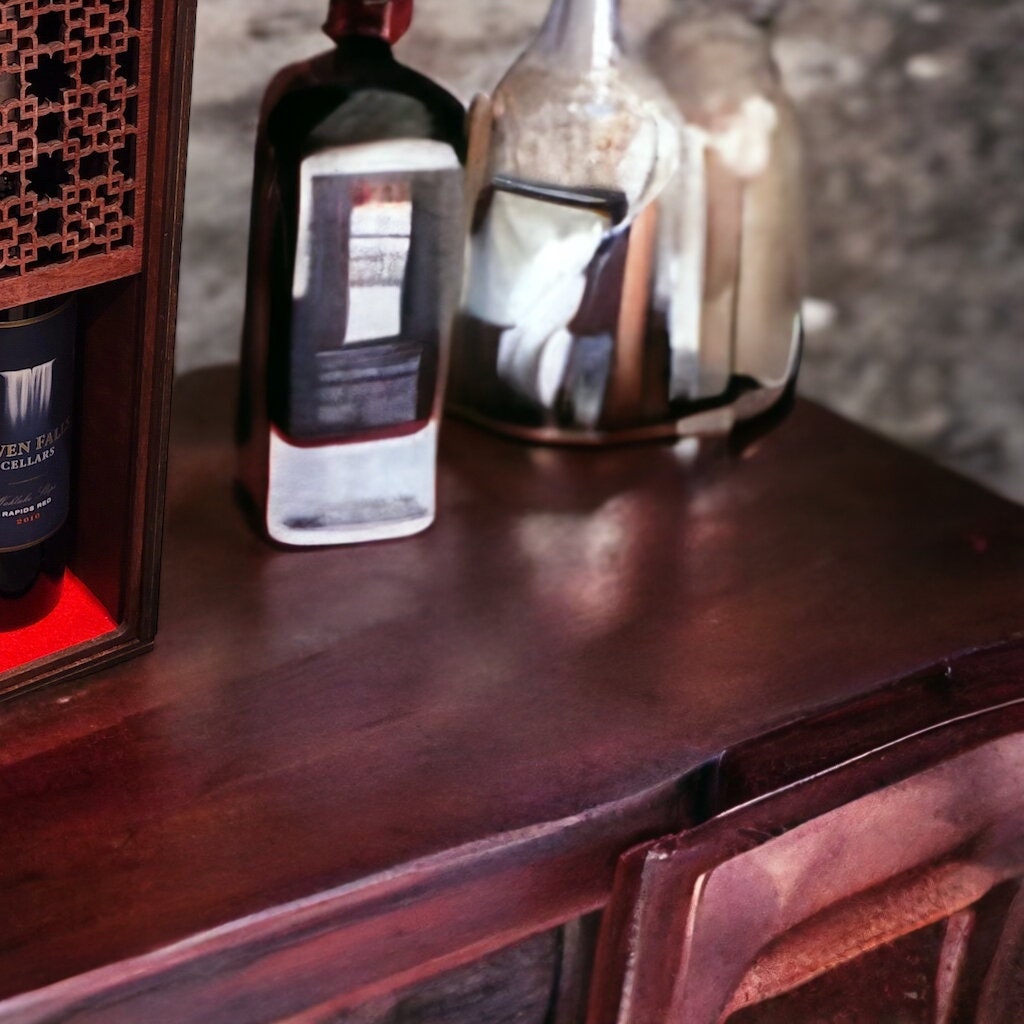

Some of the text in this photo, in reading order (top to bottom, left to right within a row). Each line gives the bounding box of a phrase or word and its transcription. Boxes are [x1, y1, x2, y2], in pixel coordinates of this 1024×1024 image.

[0, 446, 56, 471] CELLARS
[2, 497, 52, 518] RAPIDS RED
